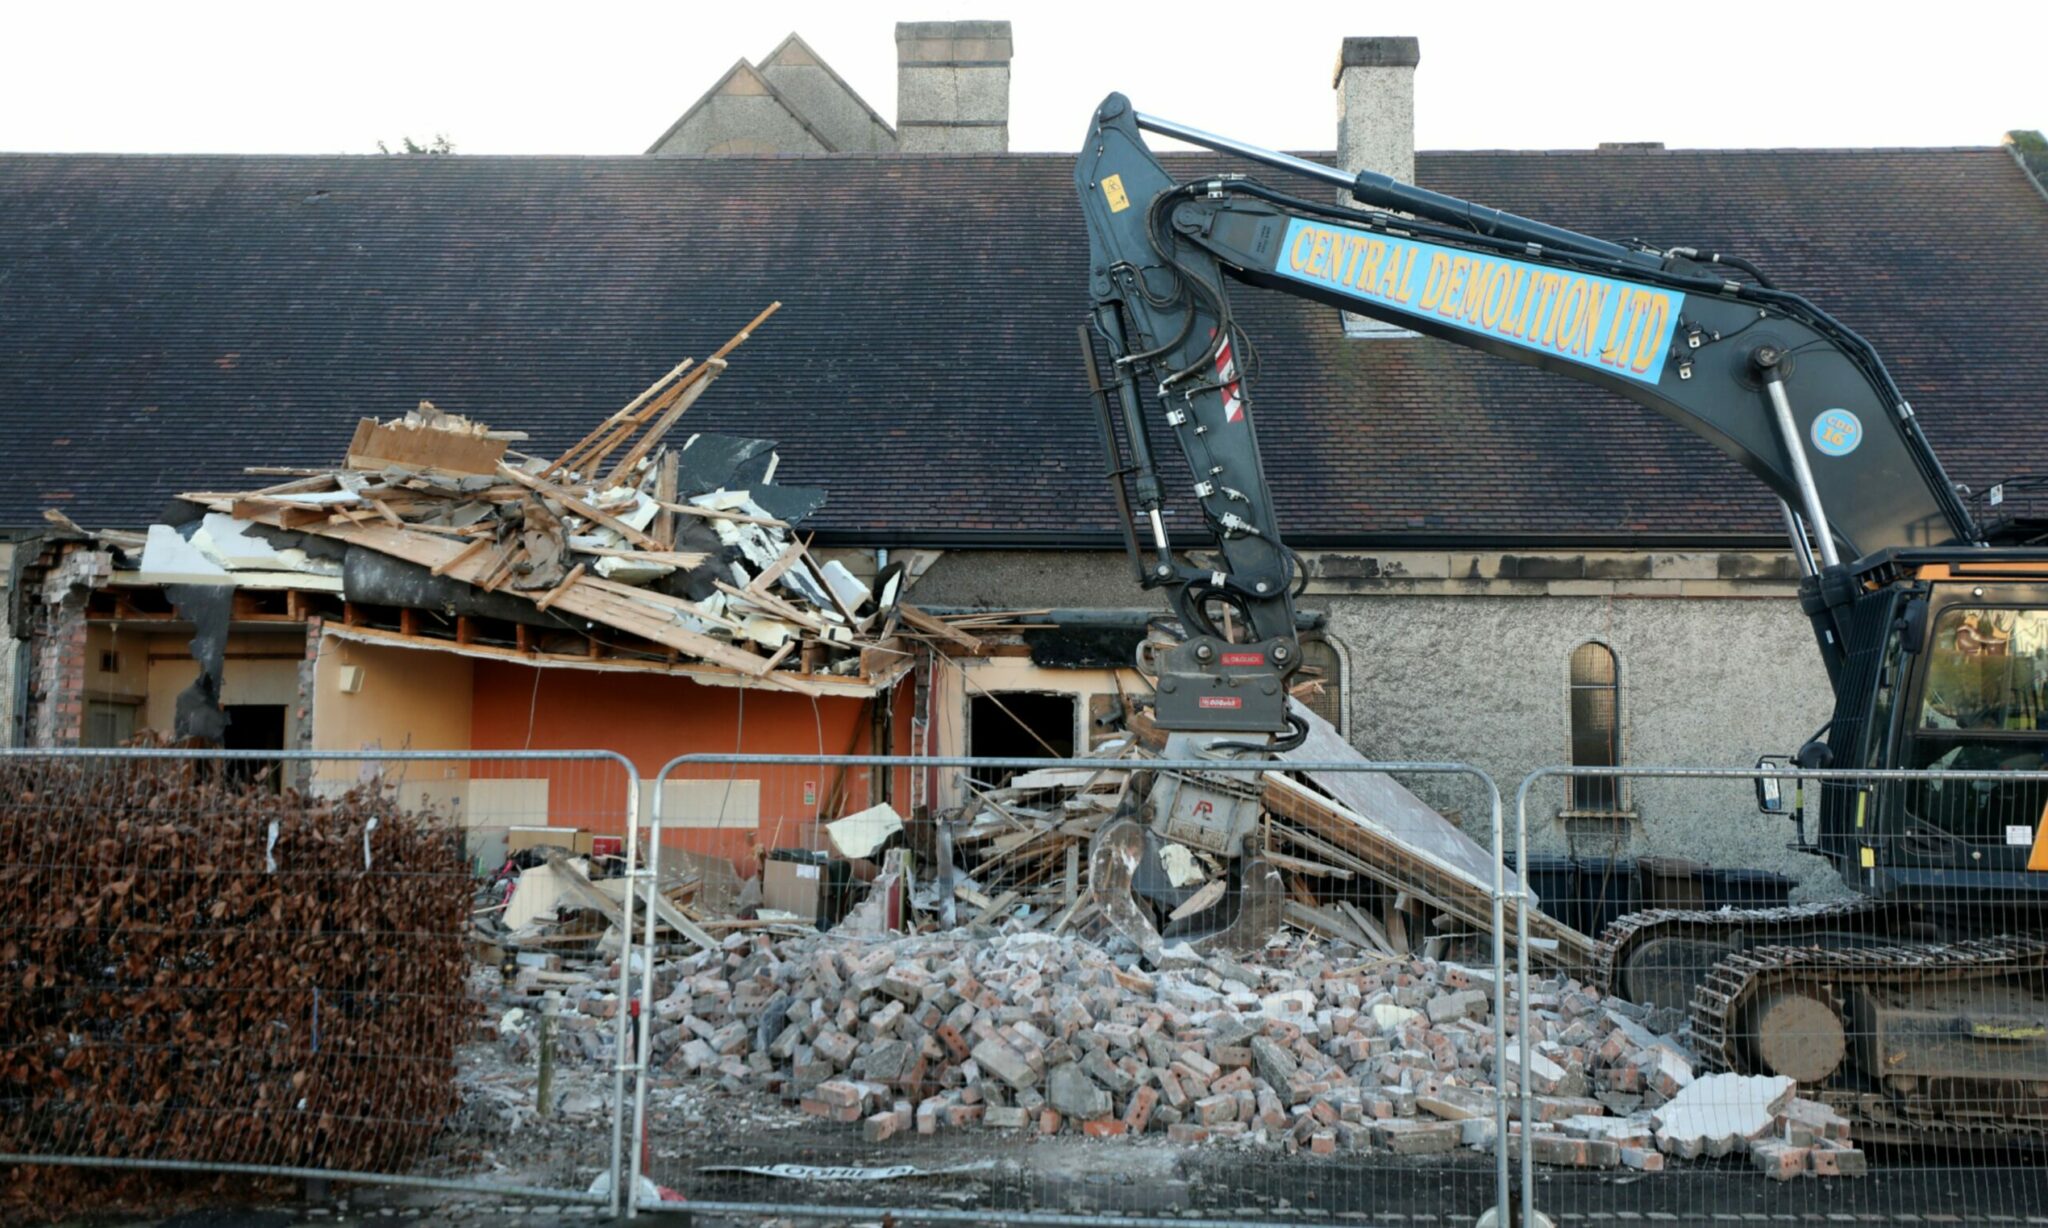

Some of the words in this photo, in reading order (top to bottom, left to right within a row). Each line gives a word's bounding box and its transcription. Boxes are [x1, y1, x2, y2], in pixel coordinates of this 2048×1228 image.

[1290, 225, 1419, 304] CENTRAL
[1418, 251, 1612, 358] DEMOLITION
[1600, 287, 1670, 374] LTD
[1822, 427, 1844, 446] 16
